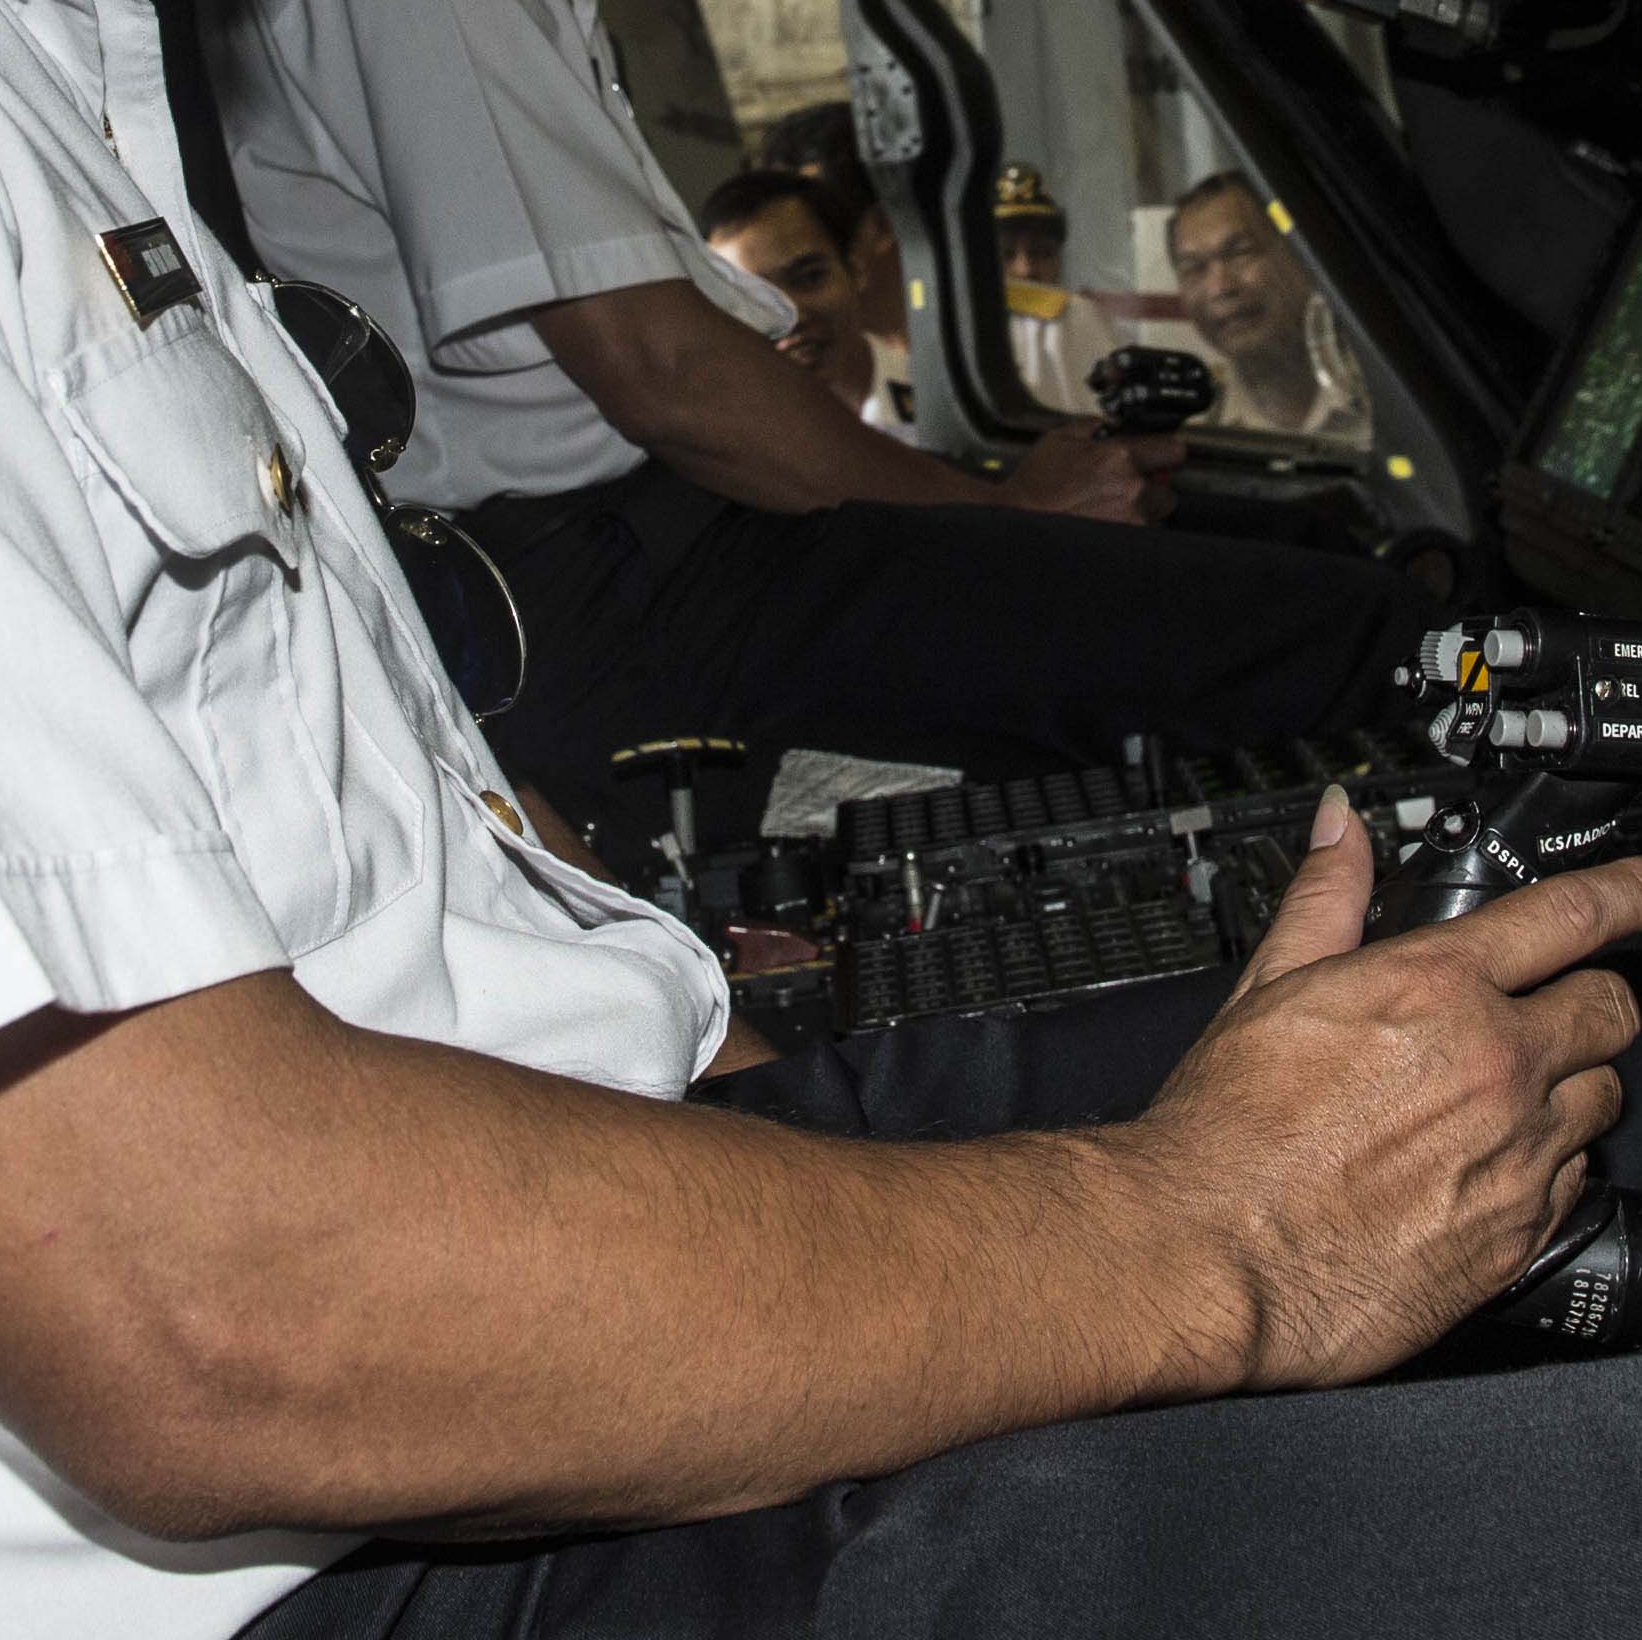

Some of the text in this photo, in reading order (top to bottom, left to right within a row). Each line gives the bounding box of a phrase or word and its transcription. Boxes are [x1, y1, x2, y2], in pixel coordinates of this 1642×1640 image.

[1464, 701, 1485, 716] WPN
[1456, 721, 1476, 735] FIRE
[1539, 822, 1611, 854] ICS/RADIO
[1486, 838, 1525, 880] DSPL
